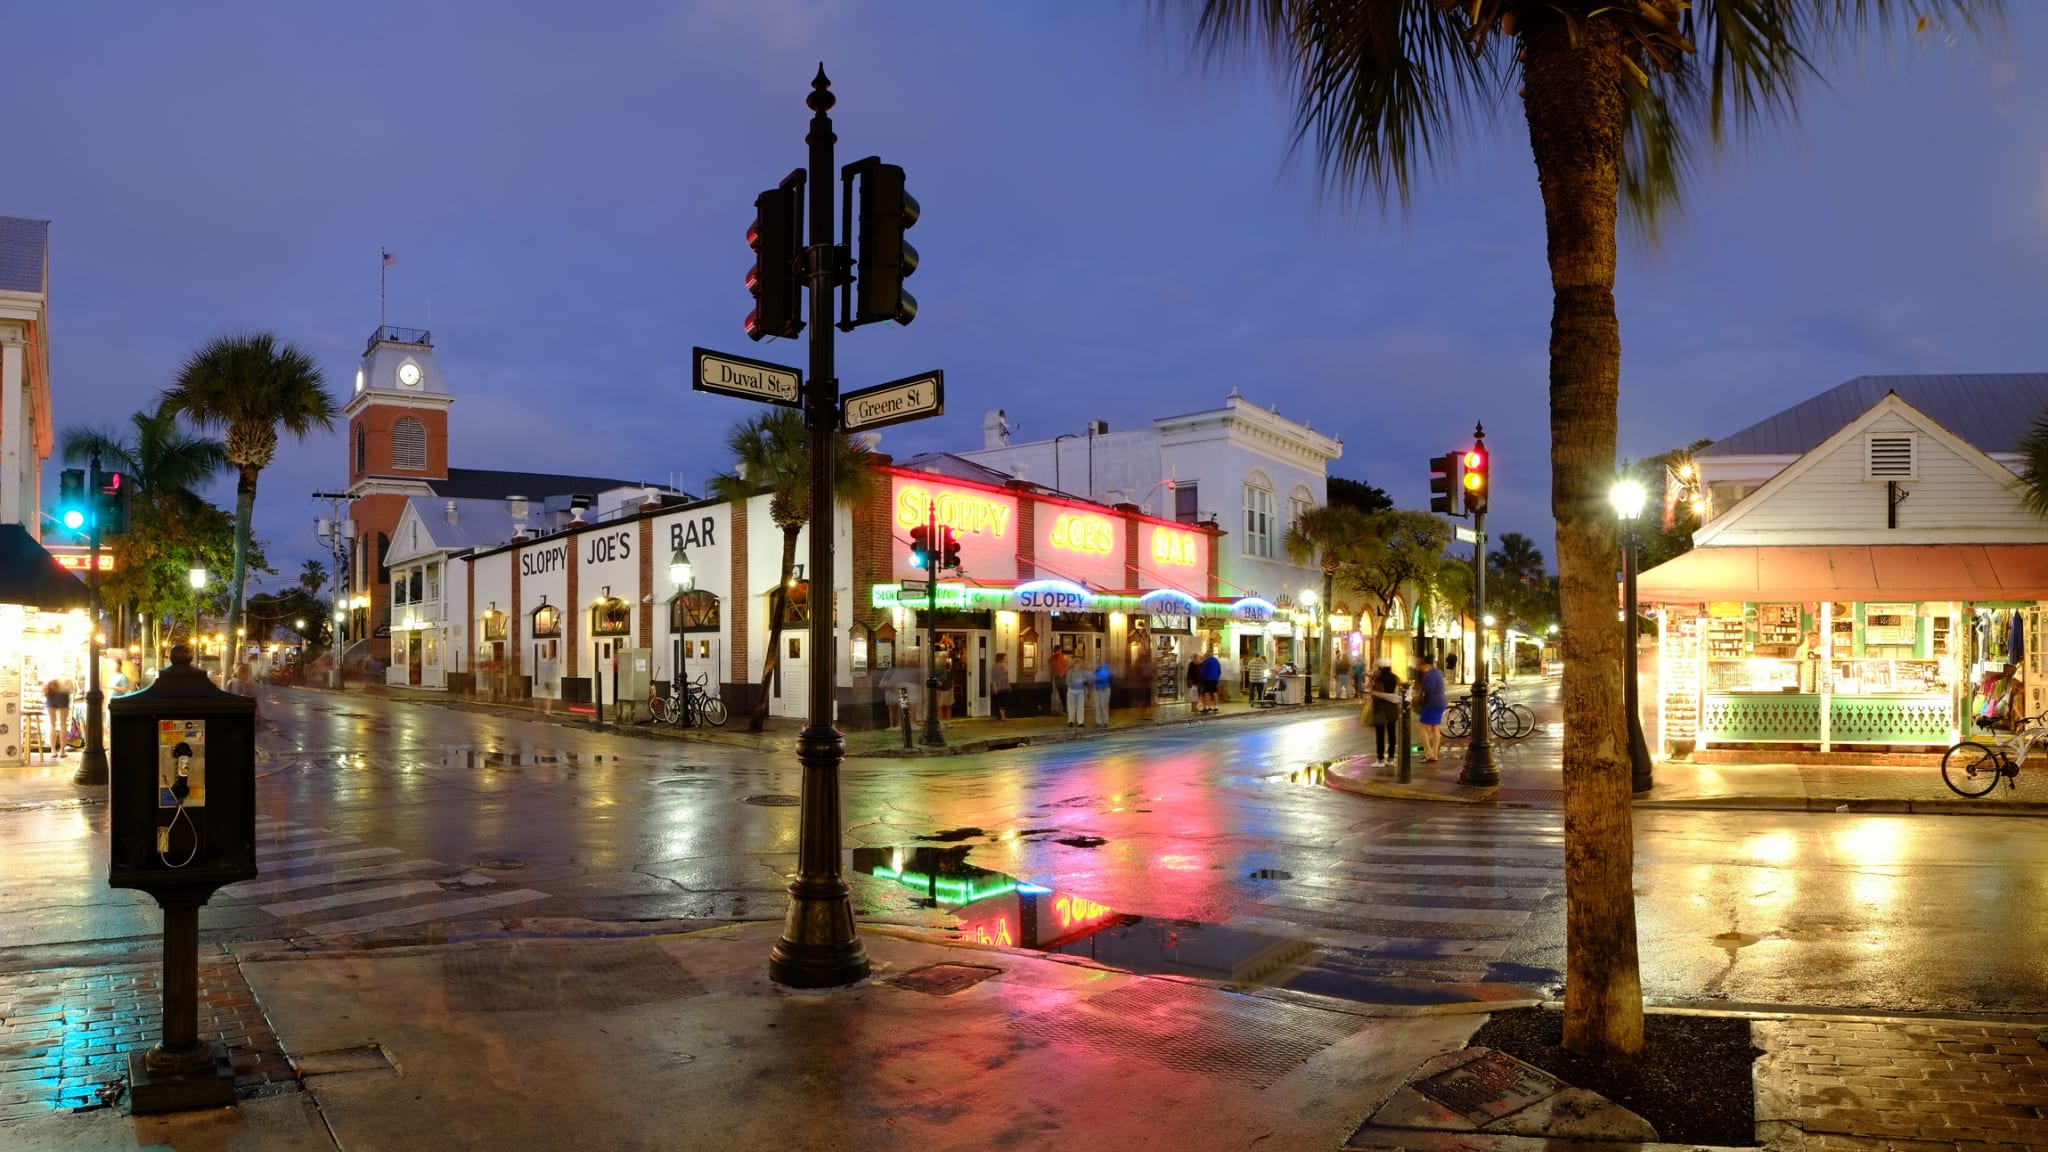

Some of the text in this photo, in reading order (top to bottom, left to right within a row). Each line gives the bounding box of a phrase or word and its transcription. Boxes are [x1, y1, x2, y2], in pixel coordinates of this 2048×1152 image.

[720, 364, 781, 393] Duval St
[858, 389, 921, 419] Greene St
[896, 486, 1197, 564] SLOPPY JOE'S BAR
[522, 516, 716, 576] SLOPPY JOE'S BAR
[1020, 591, 1265, 619] SLOPPY JOE'S BAR
